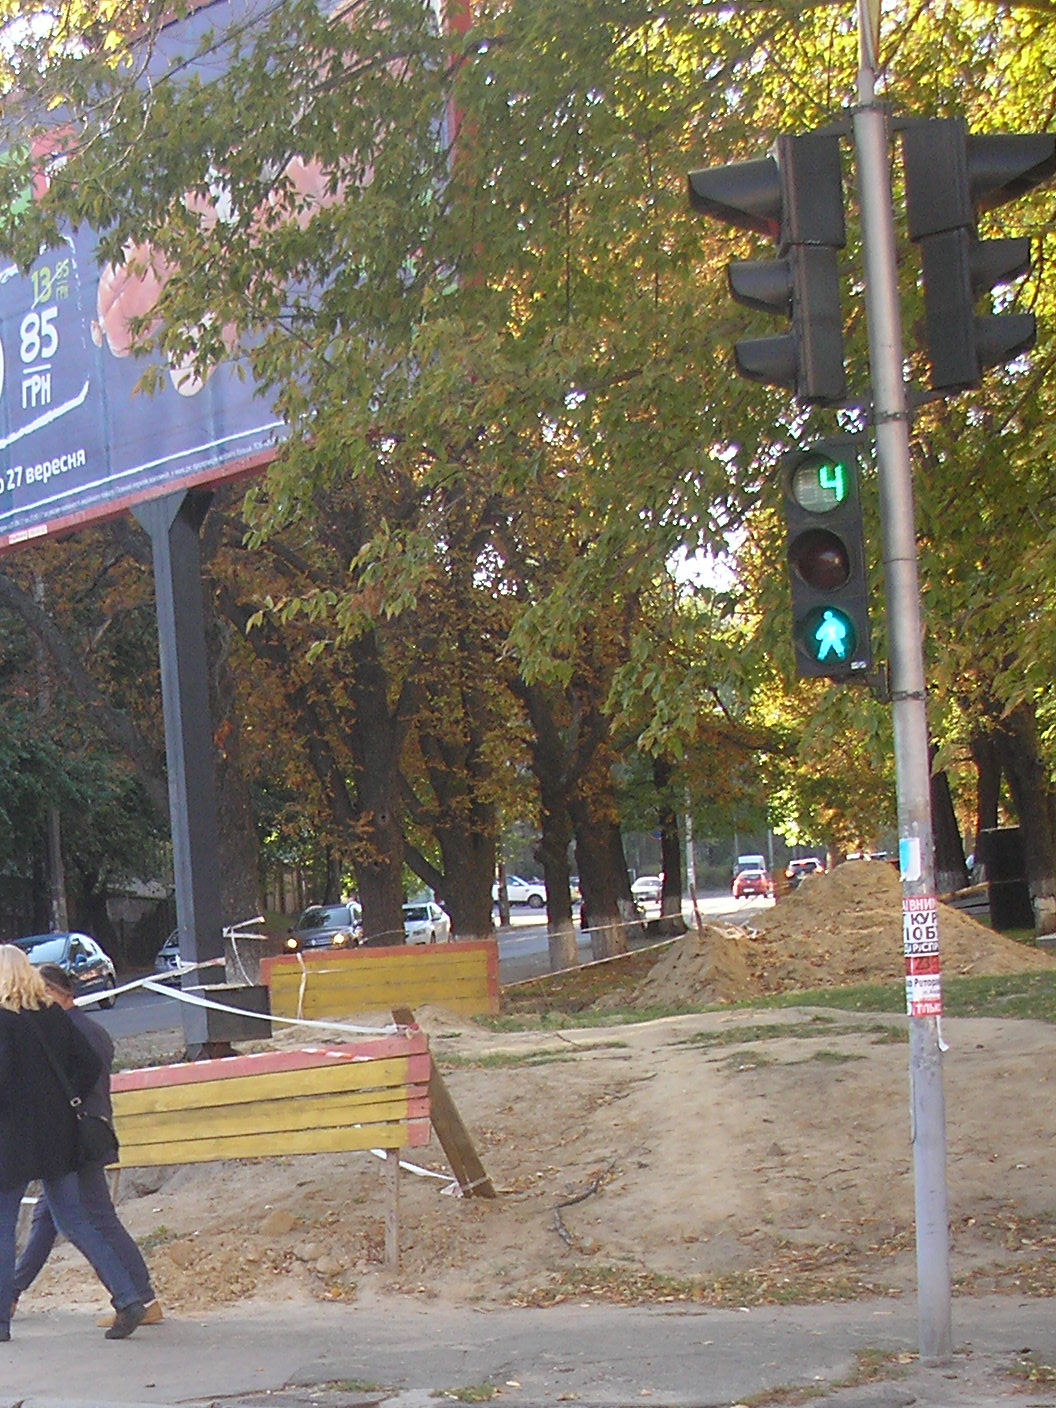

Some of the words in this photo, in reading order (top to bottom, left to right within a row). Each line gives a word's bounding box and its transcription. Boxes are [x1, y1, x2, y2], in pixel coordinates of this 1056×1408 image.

[31, 266, 52, 302] 13
[20, 306, 58, 363] 85
[22, 373, 51, 409] ГРН
[6, 466, 23, 490] 27
[25, 449, 86, 483] вересня
[819, 464, 844, 501] 4
